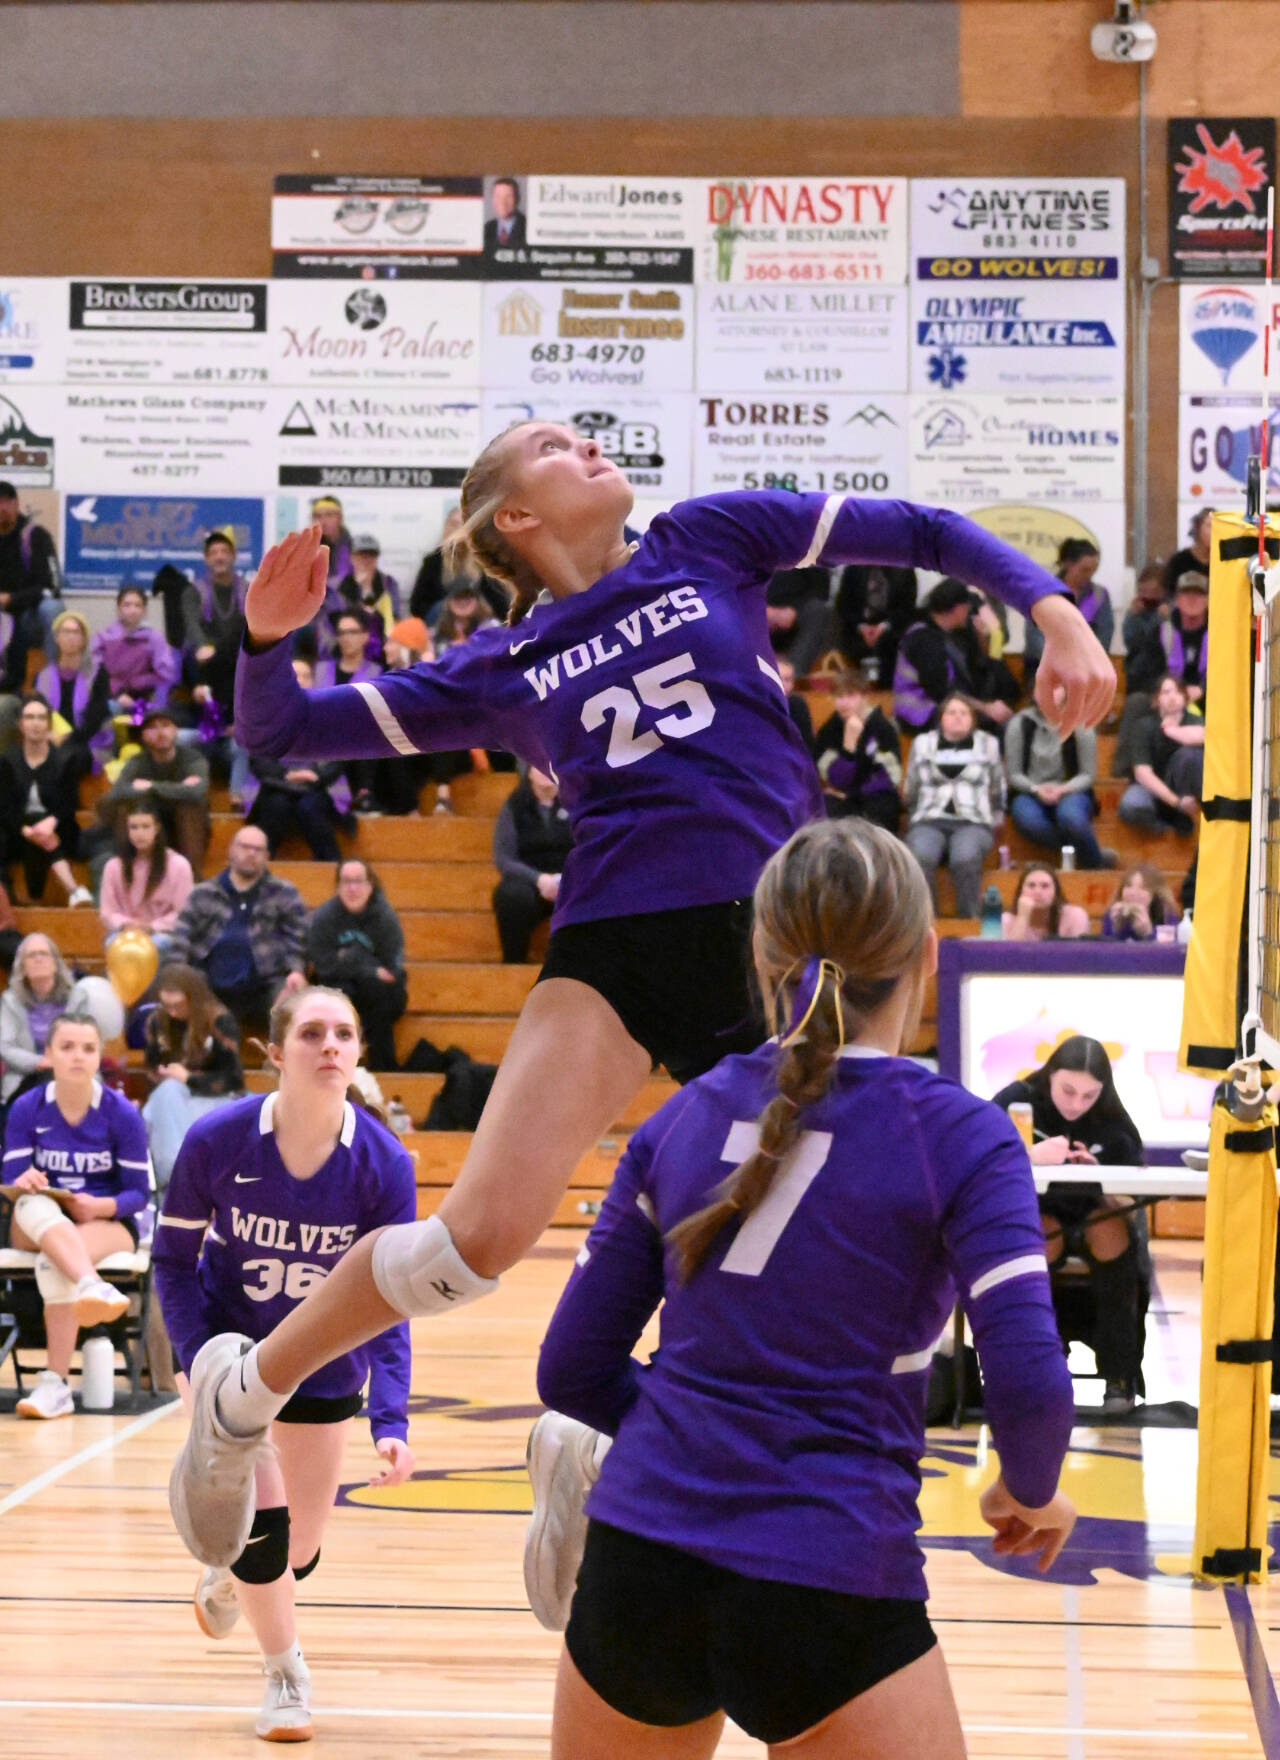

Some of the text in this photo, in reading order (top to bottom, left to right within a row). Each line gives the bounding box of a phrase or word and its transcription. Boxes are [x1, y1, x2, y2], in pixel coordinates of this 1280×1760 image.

[538, 184, 683, 206] Edward Jones
[707, 184, 894, 224] DYNASTY
[968, 190, 1110, 211] ANYTIME
[968, 212, 1110, 230] FITNESS
[786, 229, 889, 242] RESTAURANT
[744, 264, 883, 280] 360-683-6511
[930, 259, 1107, 277] GO WOLVES!
[85, 284, 255, 312] BrokersGroup
[711, 293, 779, 313] ALAN
[810, 294, 896, 313] MILLET
[926, 297, 1025, 318] OLYMPIC
[281, 320, 475, 359] Moon Palace
[922, 321, 1068, 345] AMBULANCE
[530, 343, 646, 364] 683-4970
[530, 367, 645, 385] Go Wolves!
[764, 367, 843, 383] 683-1119
[67, 396, 267, 412] Mathews Glass Company
[700, 398, 830, 428] TORRES
[708, 432, 827, 447] Real Estate
[1028, 430, 1120, 446] HOMES
[1190, 425, 1235, 473] GO
[523, 585, 709, 702] WOLVES
[580, 651, 717, 769] 25
[35, 1146, 113, 1174] WOLVES
[719, 1119, 834, 1277] 7
[231, 1206, 358, 1255] WOLVES
[242, 1258, 330, 1302] 36
